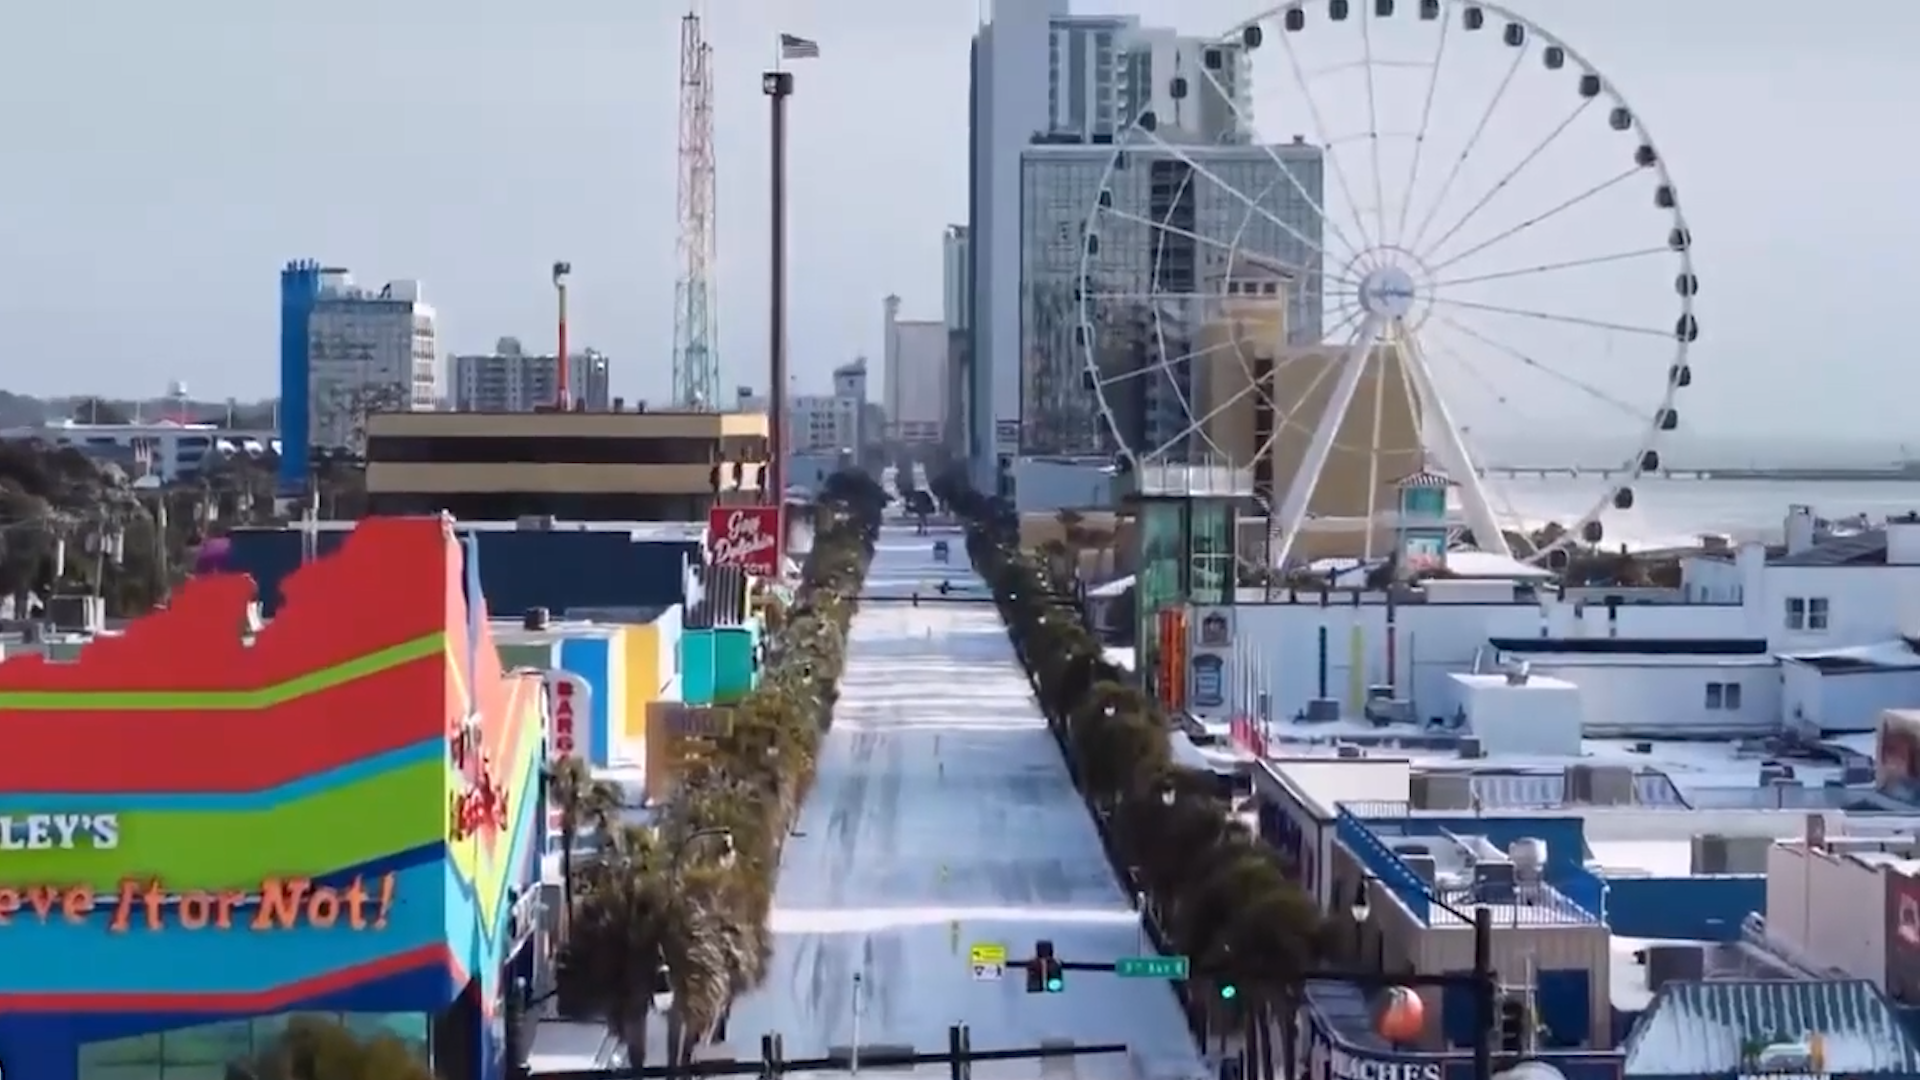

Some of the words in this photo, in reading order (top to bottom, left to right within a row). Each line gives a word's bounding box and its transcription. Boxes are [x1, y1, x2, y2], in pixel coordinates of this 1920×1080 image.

[556, 681, 575, 760] BARG
[0, 813, 119, 850] LEY'S
[0, 883, 95, 926] eve
[110, 873, 168, 932] It
[178, 889, 246, 930] or
[250, 868, 396, 932] Not!
